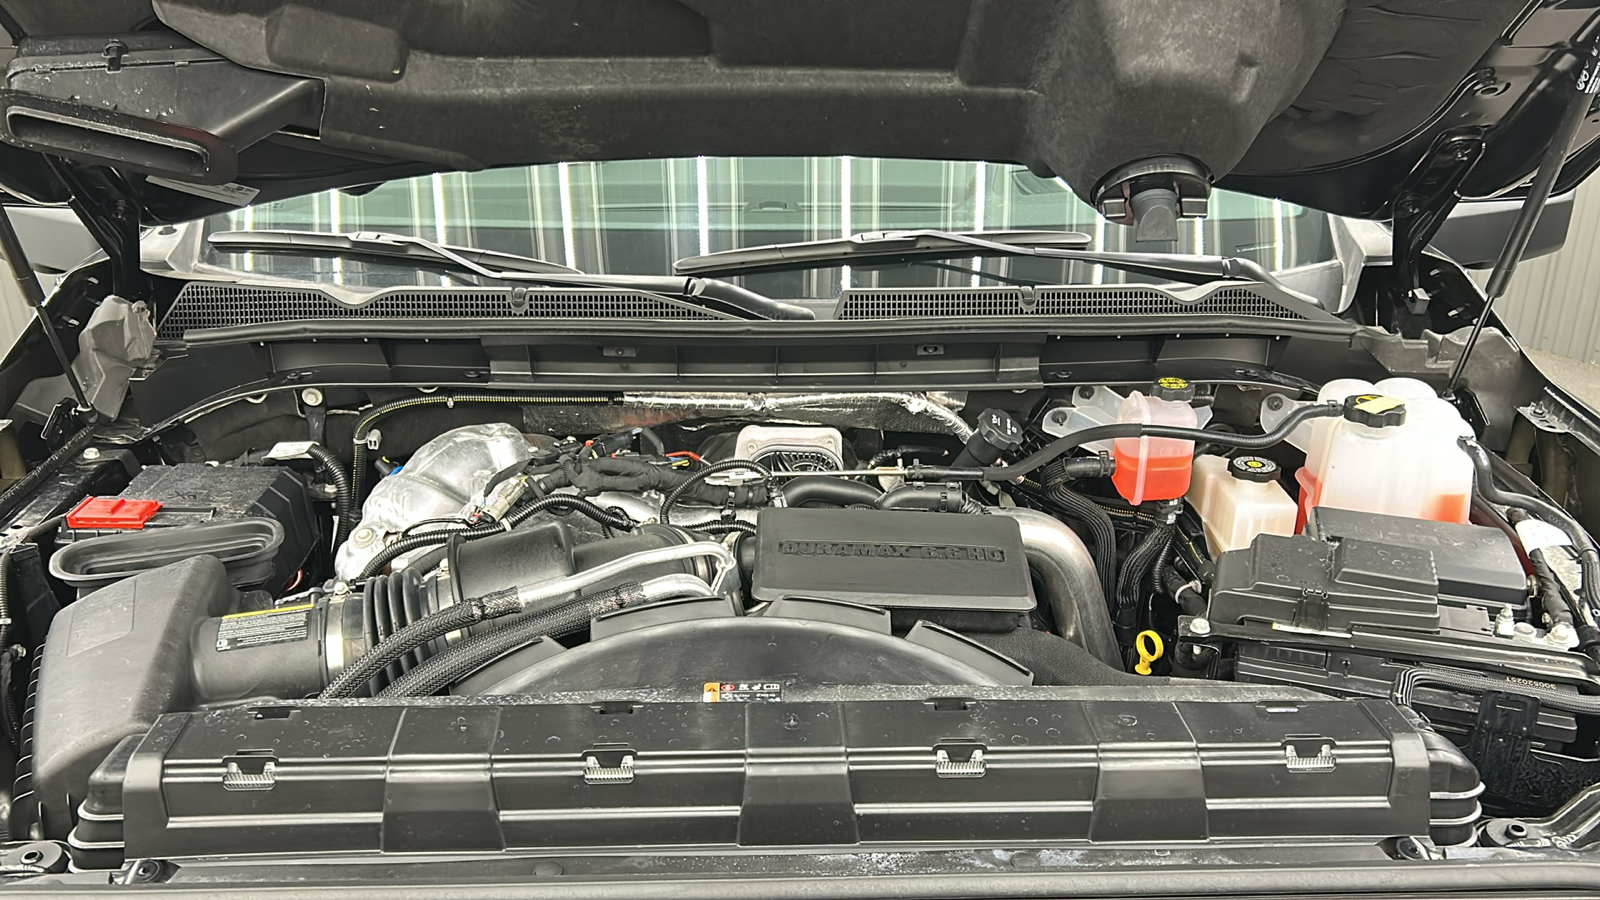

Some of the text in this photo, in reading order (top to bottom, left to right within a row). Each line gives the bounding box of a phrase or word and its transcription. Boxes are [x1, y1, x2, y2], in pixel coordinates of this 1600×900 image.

[780, 541, 1005, 562] DURAMAX 6.6 HD
